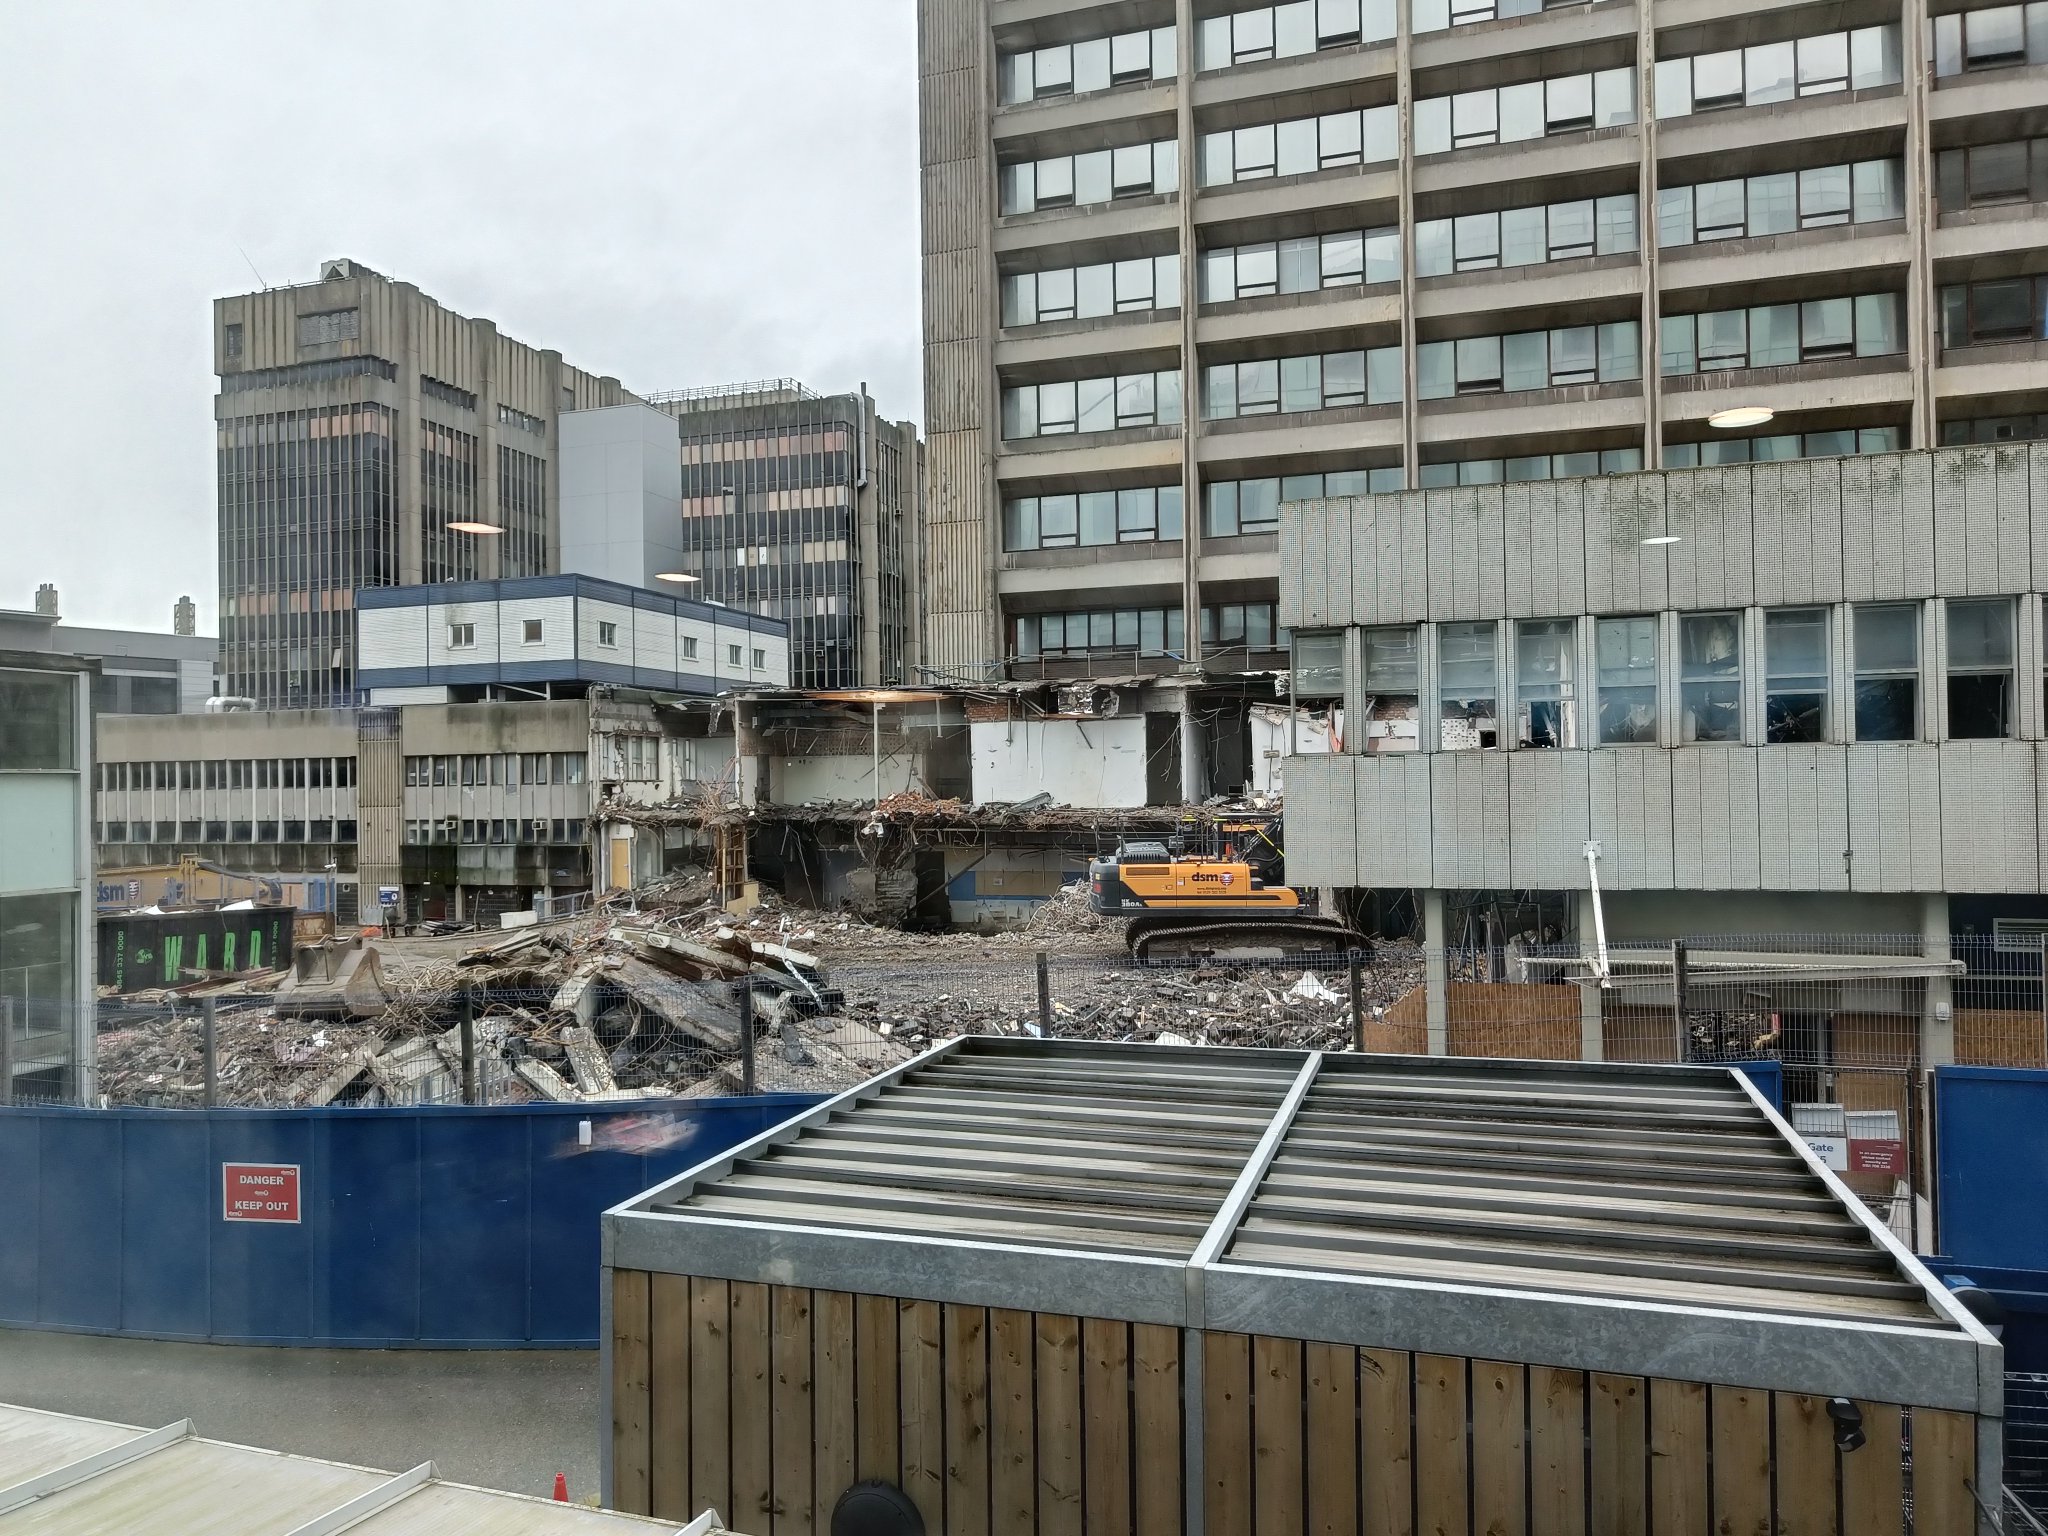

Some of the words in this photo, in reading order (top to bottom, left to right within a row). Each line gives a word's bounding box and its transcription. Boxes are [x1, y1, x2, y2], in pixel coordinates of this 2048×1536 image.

[1191, 872, 1218, 882] dsm
[116, 953, 124, 968] 337
[165, 930, 261, 981] WARD
[1808, 1142, 1834, 1153] Gate
[240, 1175, 284, 1185] DANGER
[235, 1200, 263, 1210] KEEP
[266, 1202, 289, 1211] OUT
